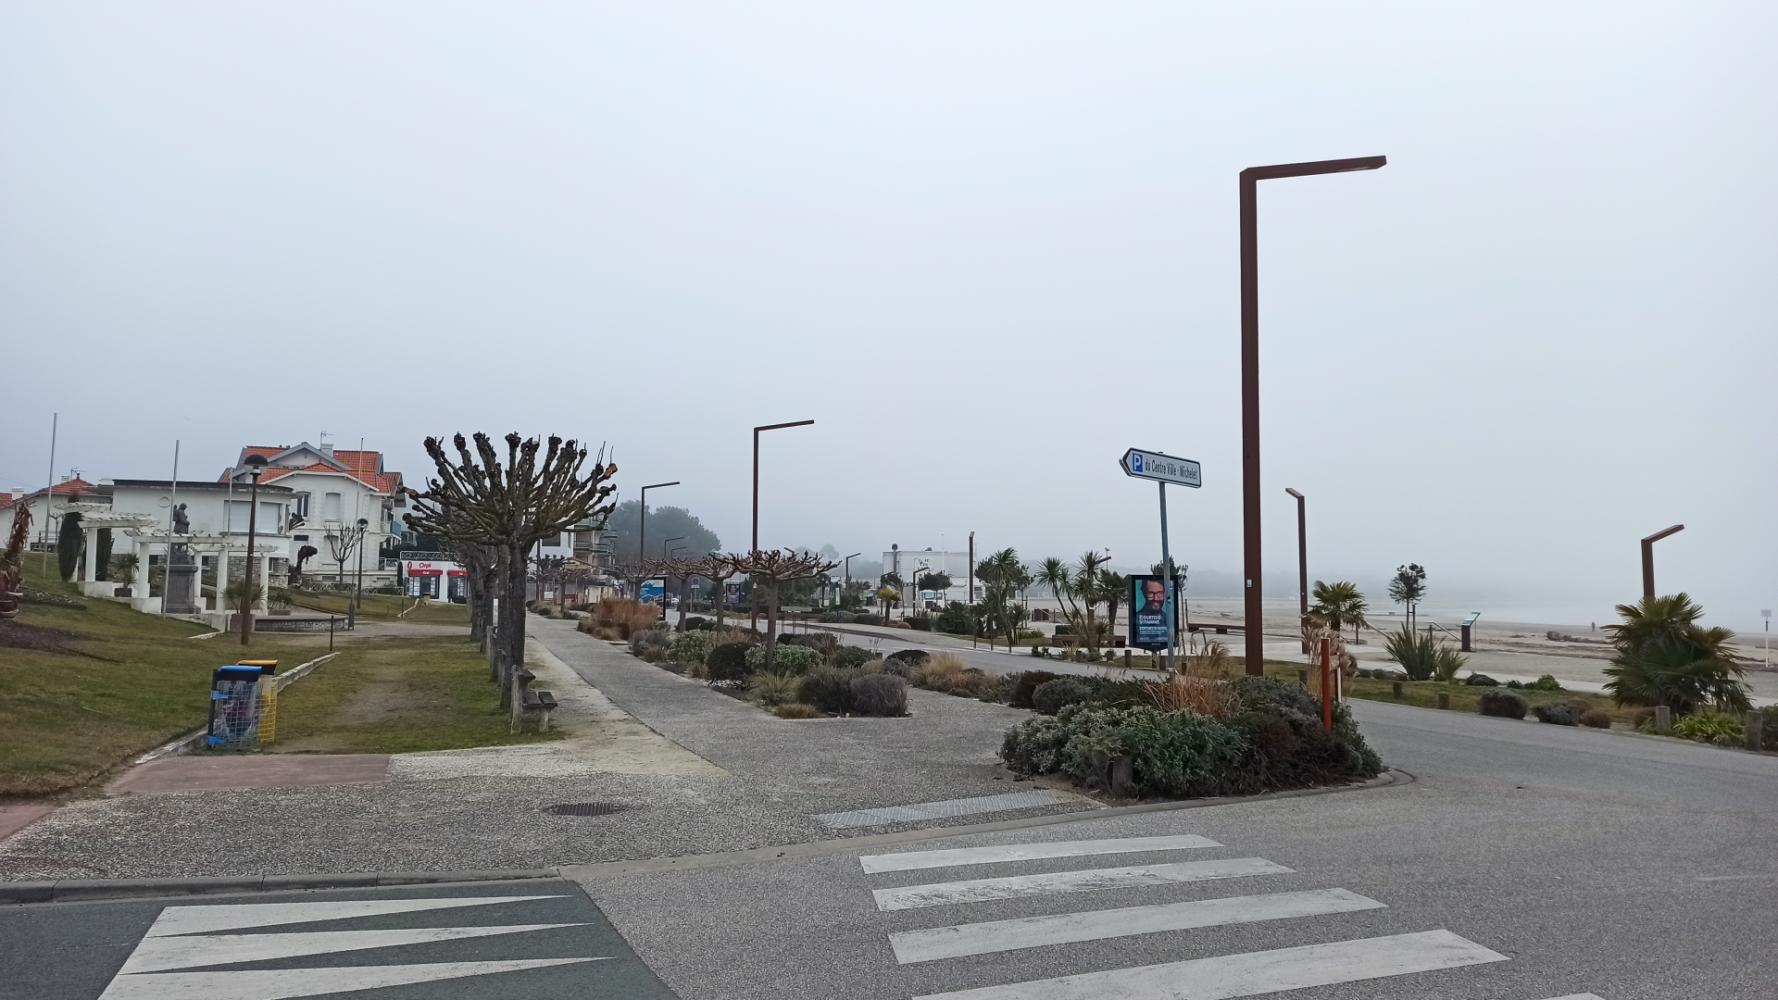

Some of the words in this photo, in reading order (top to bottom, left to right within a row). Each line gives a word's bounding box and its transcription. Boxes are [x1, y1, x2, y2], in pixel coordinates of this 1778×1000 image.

[1134, 454, 1141, 470] P
[1145, 458, 1151, 471] du
[1152, 459, 1166, 475] Centre
[1166, 462, 1177, 476] Ville
[1180, 466, 1198, 480] Michelet
